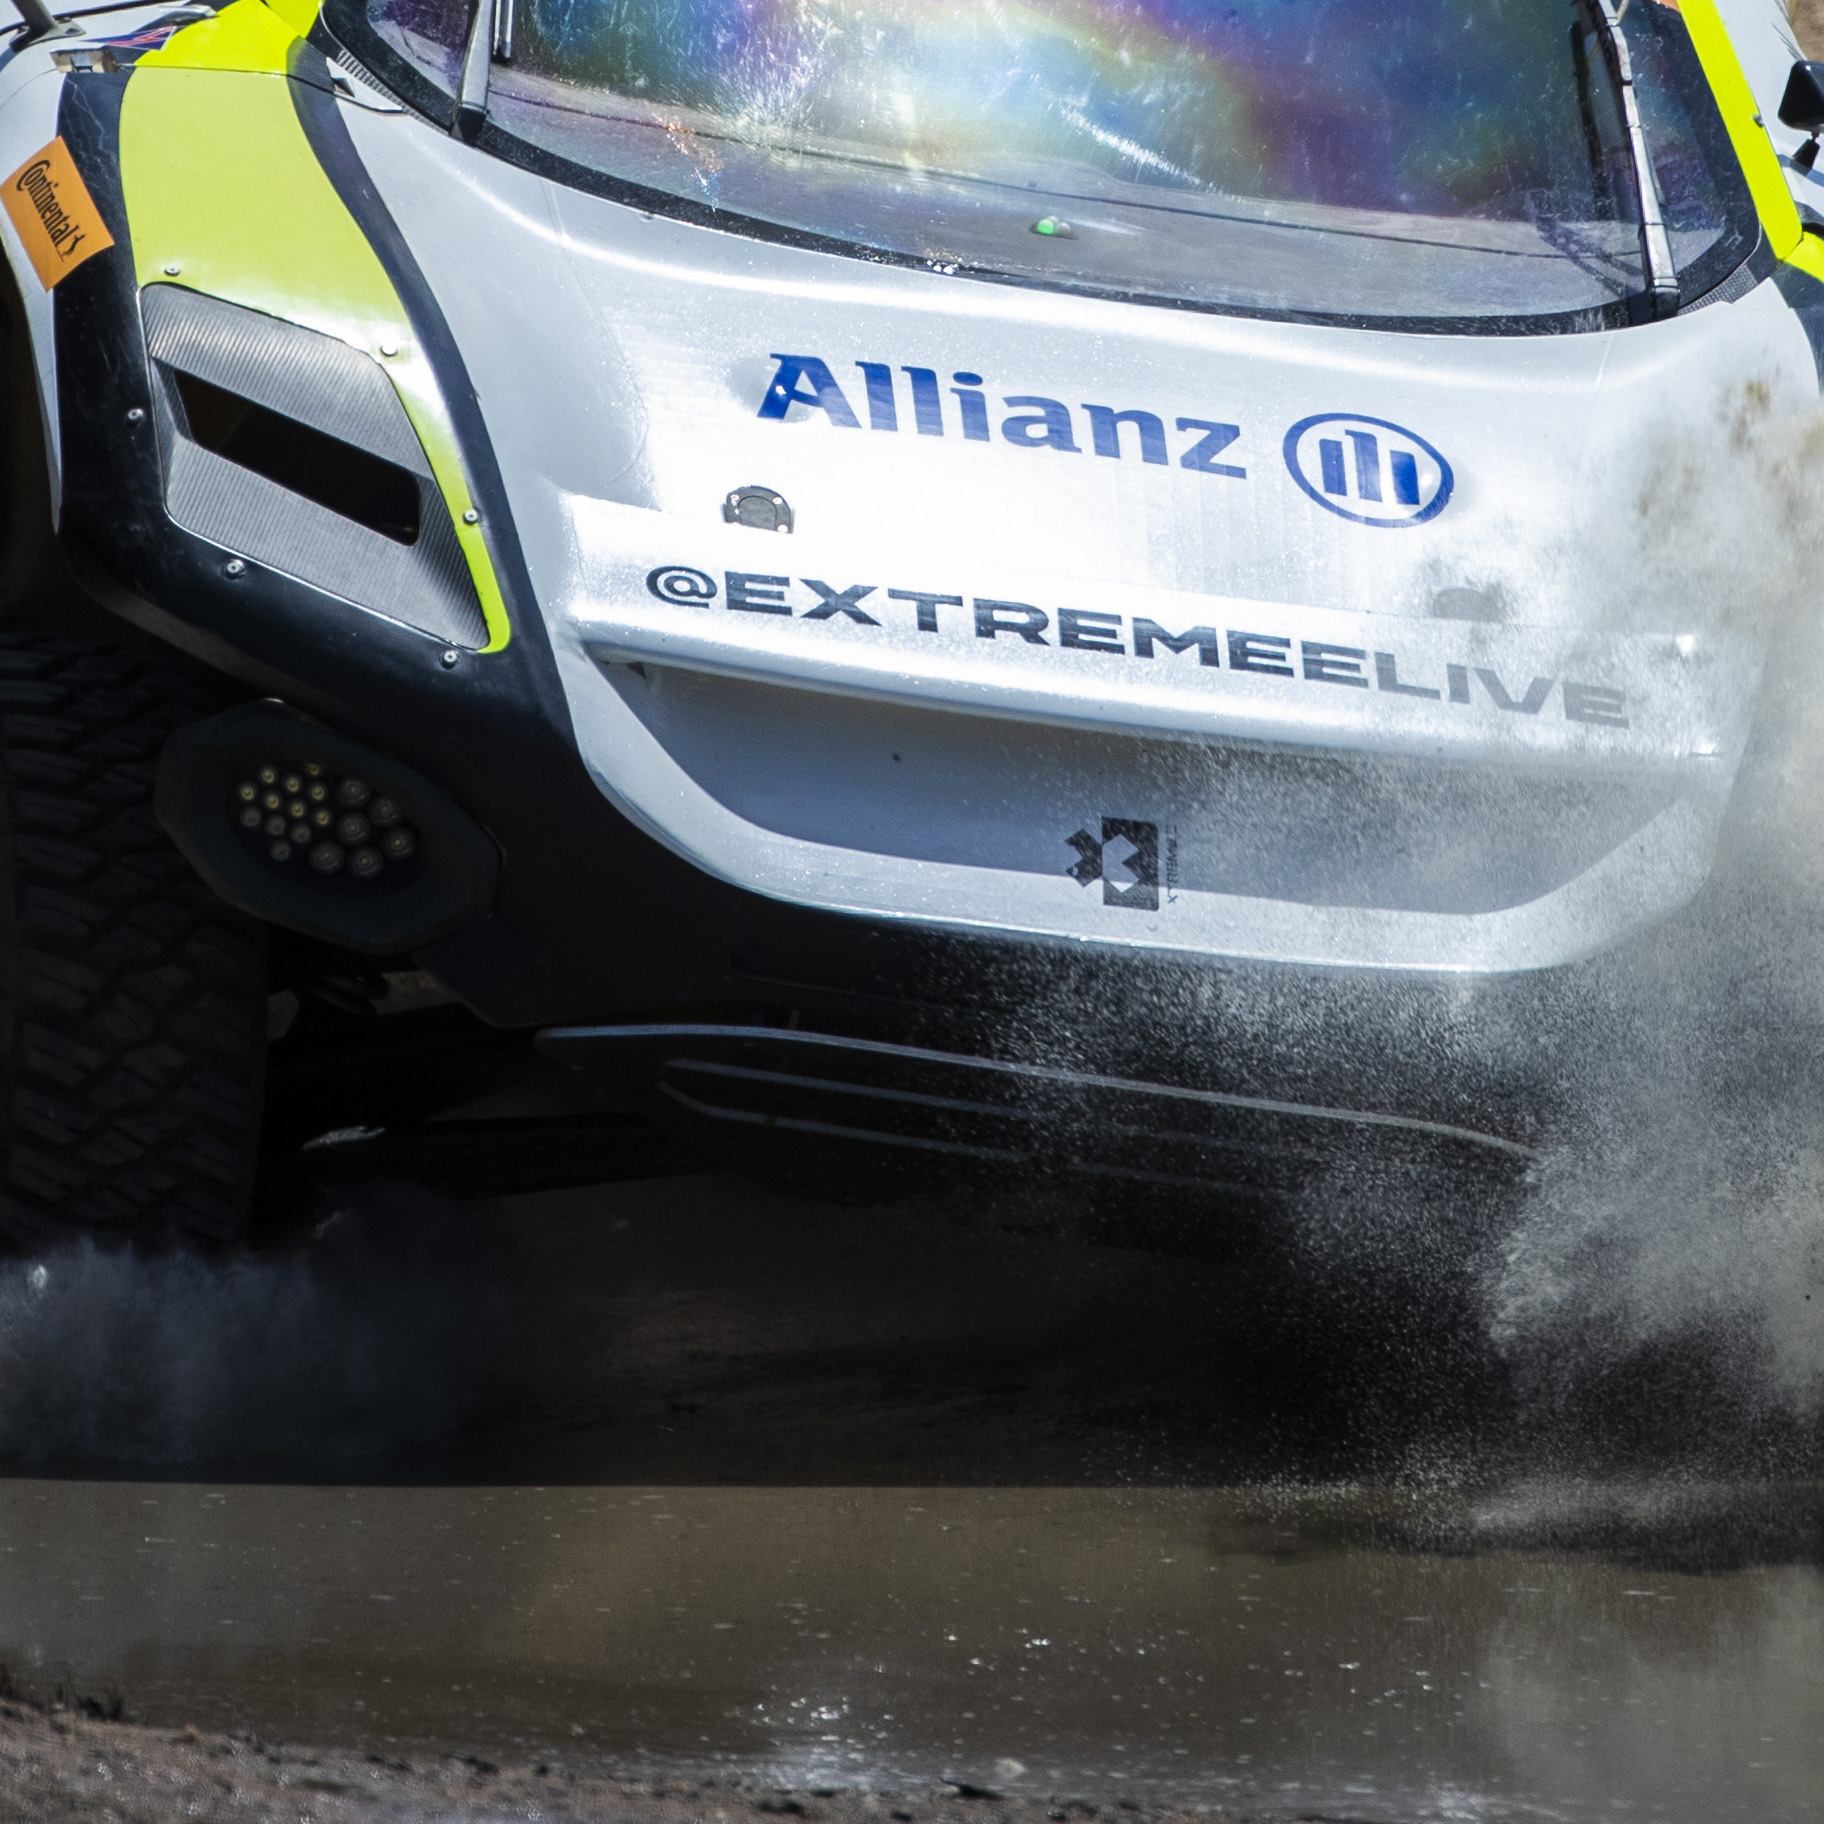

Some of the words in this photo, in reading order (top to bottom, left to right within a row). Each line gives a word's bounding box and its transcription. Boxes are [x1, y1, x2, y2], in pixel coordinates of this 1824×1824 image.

[17, 159, 80, 248] Continental
[757, 353, 1247, 479] Allianz
[644, 565, 1630, 730] @EXTREMEELIVE
